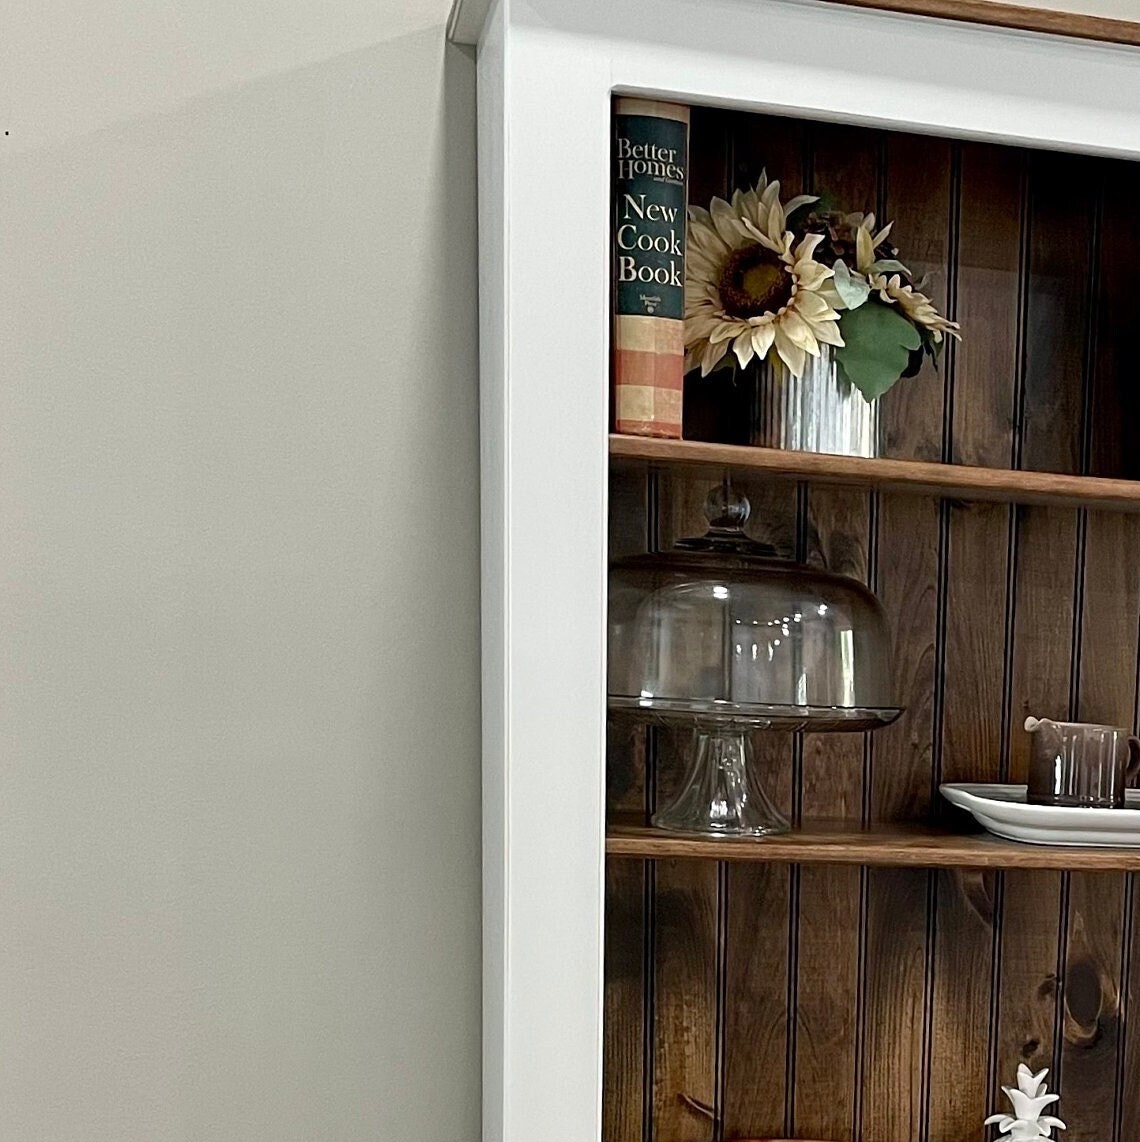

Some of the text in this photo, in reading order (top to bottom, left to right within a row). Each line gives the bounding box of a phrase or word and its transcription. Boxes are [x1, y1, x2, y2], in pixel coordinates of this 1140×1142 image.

[617, 138, 677, 163] Better
[618, 159, 684, 180] Homes
[624, 194, 678, 223] New
[617, 224, 683, 256] Cook
[618, 256, 683, 287] Book
